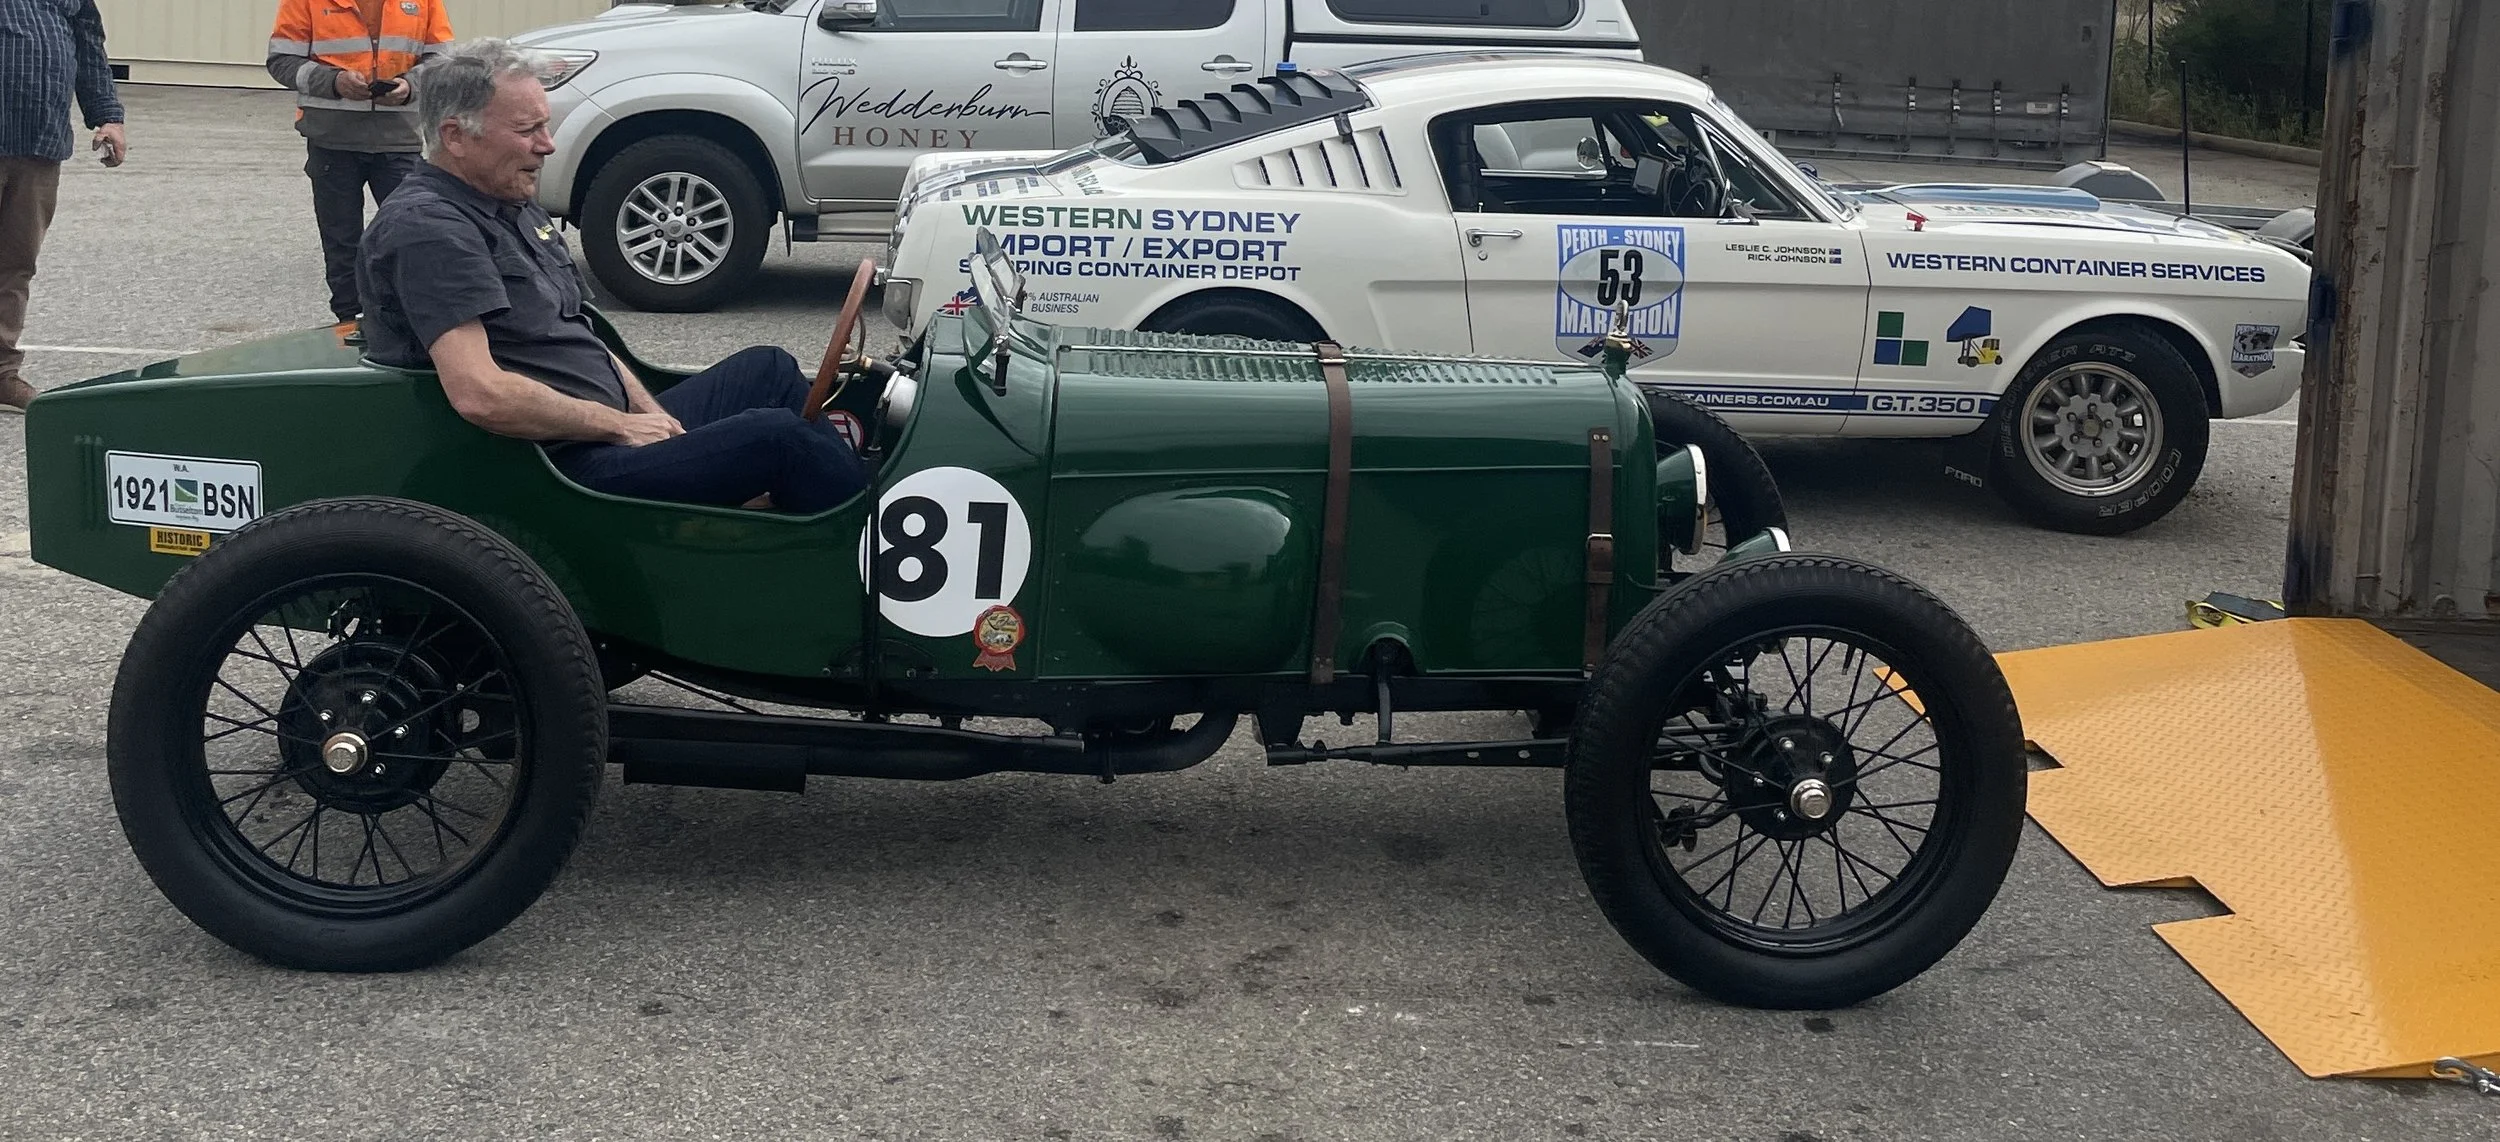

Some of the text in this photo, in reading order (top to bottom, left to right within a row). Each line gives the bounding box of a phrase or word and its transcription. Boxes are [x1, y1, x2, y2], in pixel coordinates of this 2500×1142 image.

[801, 77, 1050, 135] Wedderburn
[834, 126, 979, 149] HONEY
[962, 205, 1300, 233] WESTERN SYDNEY
[1123, 237, 1134, 257] /
[1143, 237, 1287, 261] EXPORT
[1561, 229, 1608, 263] PERTH
[1624, 229, 1681, 263] SYDNEY
[1725, 243, 1760, 252] LESLIE
[1773, 246, 1826, 255] JOHNSON
[1747, 253, 1826, 264] RICK JOHNSON
[1887, 252, 2265, 283] WESTERN CONTAINER SERVICES
[1077, 261, 1217, 279] CONTAINER
[1223, 265, 1301, 281] DEPOT
[1597, 249, 1643, 306] 53
[1031, 303, 1079, 313] BUSINESS
[1039, 292, 1100, 303] AUSTRALIAN
[2233, 349, 2273, 361] MARATHON
[1872, 395, 1976, 413] G.T.350
[173, 464, 189, 472] W.A.
[113, 475, 255, 519] 1921 BSN
[157, 531, 203, 547] HISTORIC
[879, 495, 1009, 602] 81
